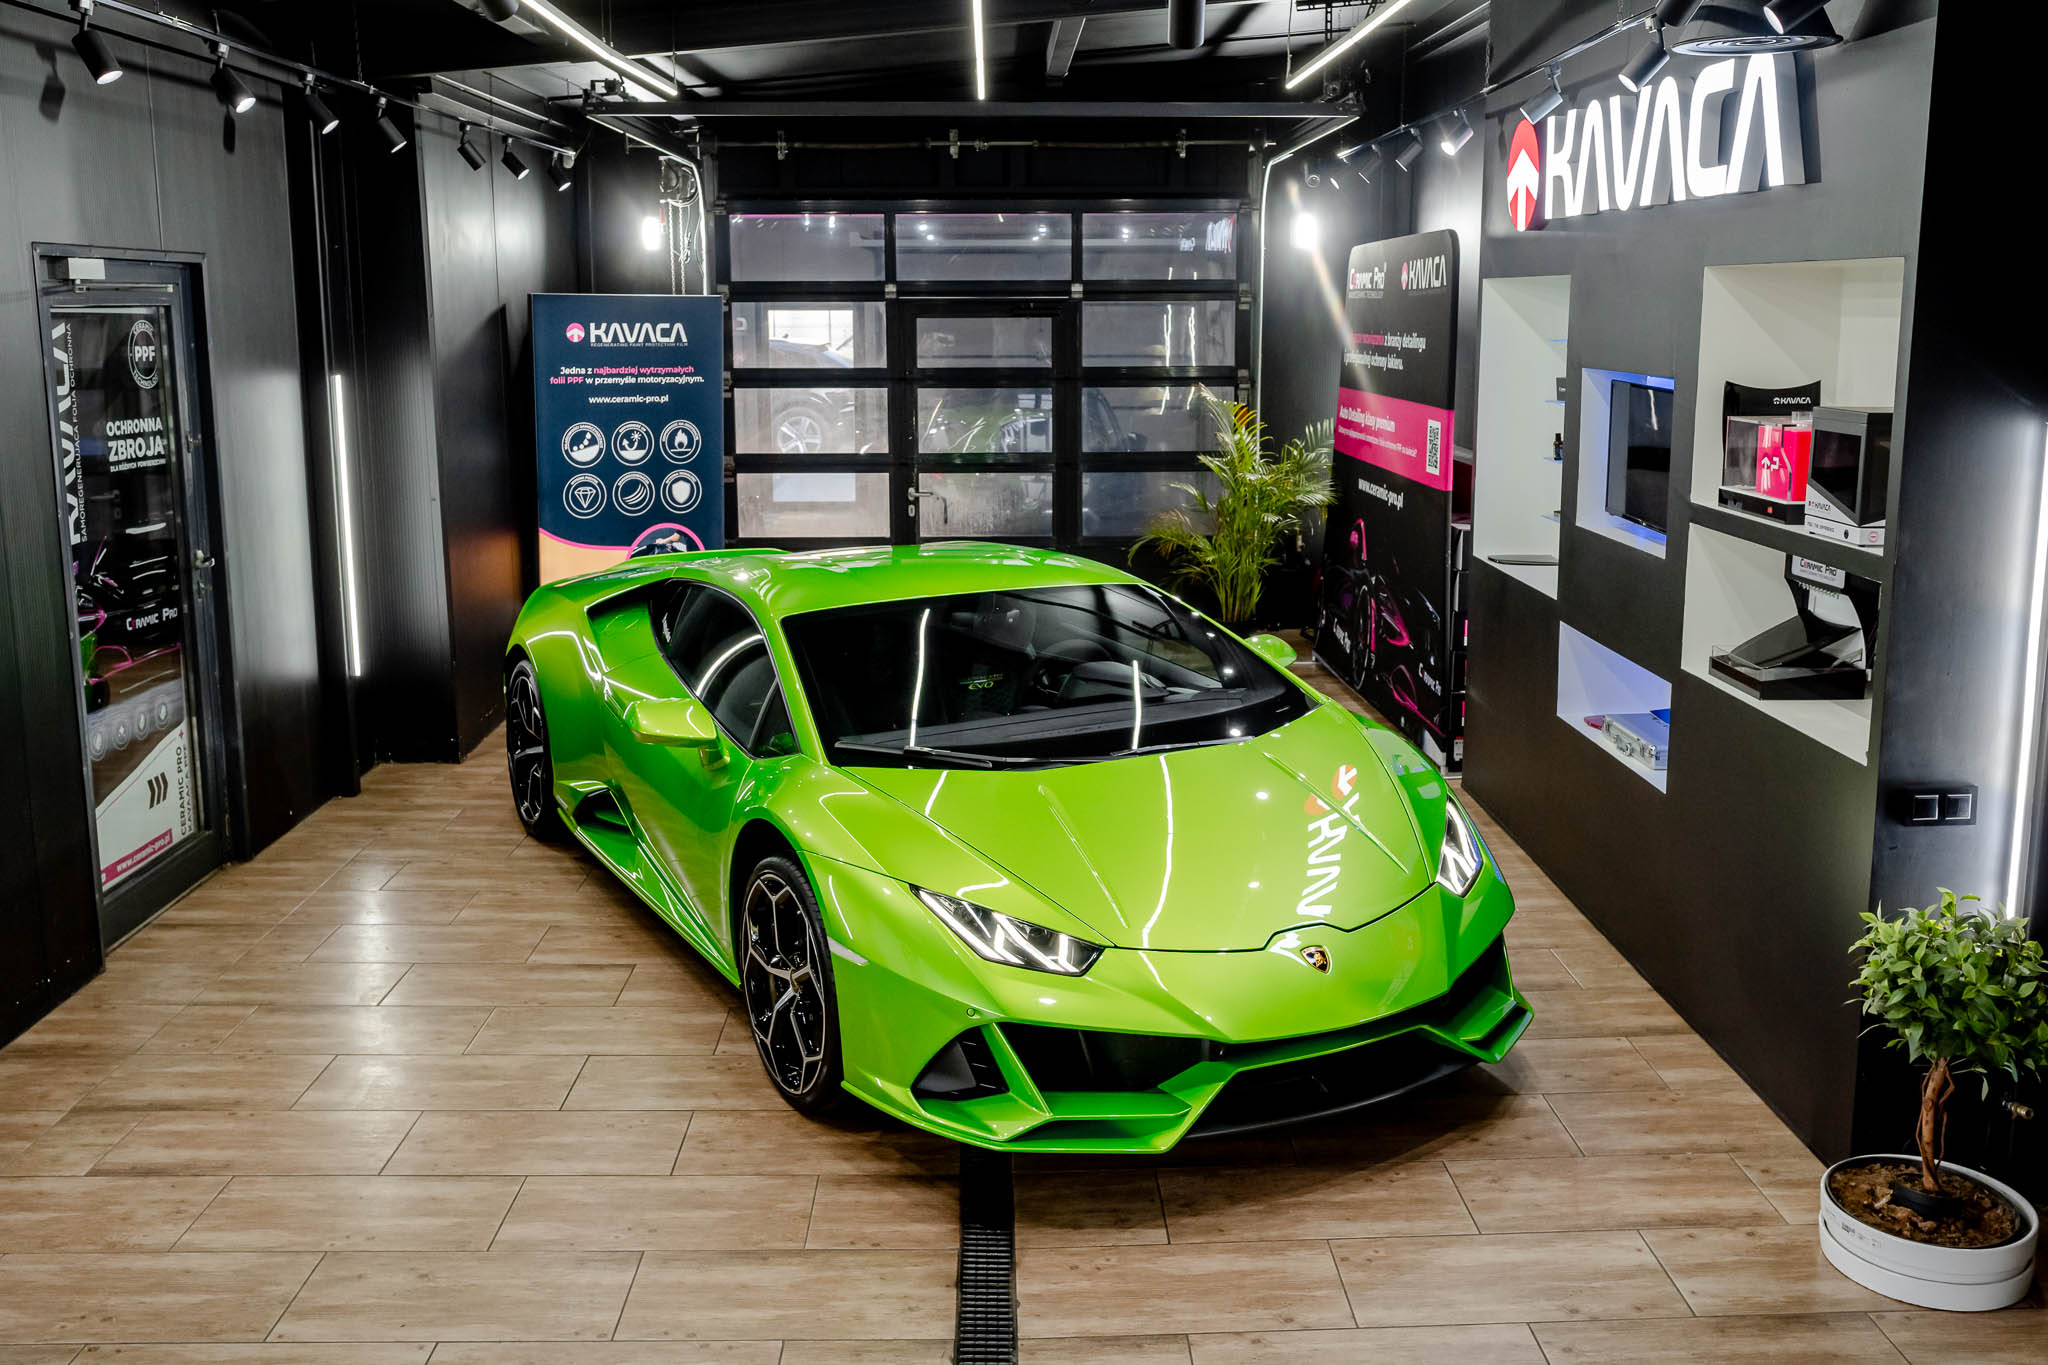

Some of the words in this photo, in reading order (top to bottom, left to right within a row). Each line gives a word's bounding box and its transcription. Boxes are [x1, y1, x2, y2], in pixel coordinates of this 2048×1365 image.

[1545, 53, 1785, 219] KAVACA
[1408, 254, 1447, 290] KAVACA
[589, 322, 688, 342] KAVACA
[66, 323, 76, 388] OCHRONNA
[134, 345, 155, 362] PPF
[550, 376, 566, 384] folii
[567, 376, 584, 384] PPF
[594, 376, 636, 386] przemyśle
[637, 375, 705, 385] motoryzacyjnym.
[560, 366, 586, 374] Jedna
[593, 366, 639, 376] najbardziej
[639, 365, 694, 376] wytrzymałych
[588, 394, 669, 404] www.ceramic-pro.pl
[1780, 396, 1812, 404] KAVACA
[106, 417, 163, 437] OCHRONNA
[108, 435, 165, 462] ZBROJA
[178, 777, 186, 835] CERAMIC
